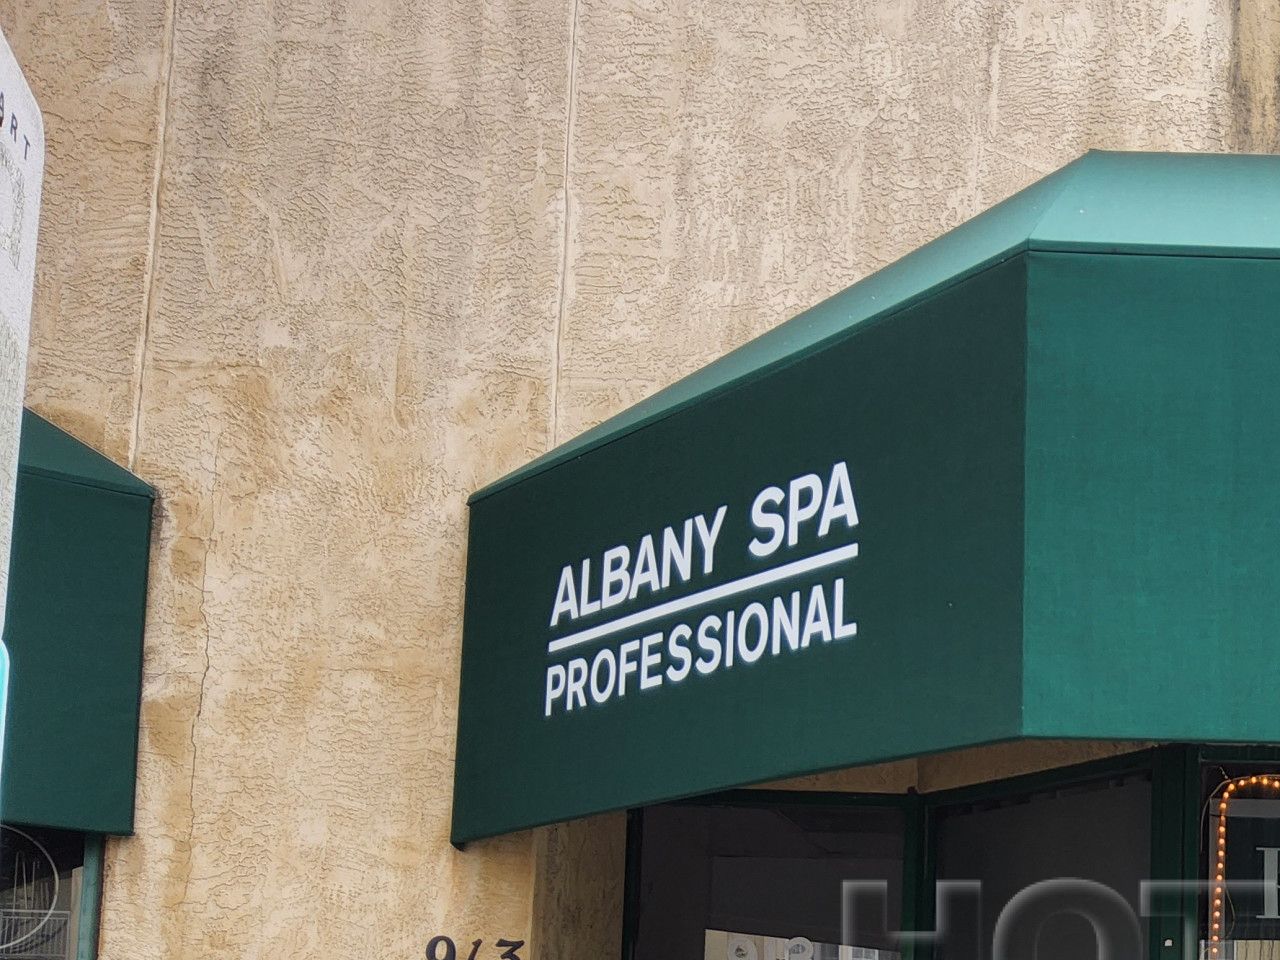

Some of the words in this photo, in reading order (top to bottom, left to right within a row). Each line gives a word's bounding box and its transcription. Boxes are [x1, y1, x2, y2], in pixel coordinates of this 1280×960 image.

[549, 505, 727, 627] ALBANY
[748, 461, 859, 557] SPA
[545, 578, 857, 716] PROFESSIONAL
